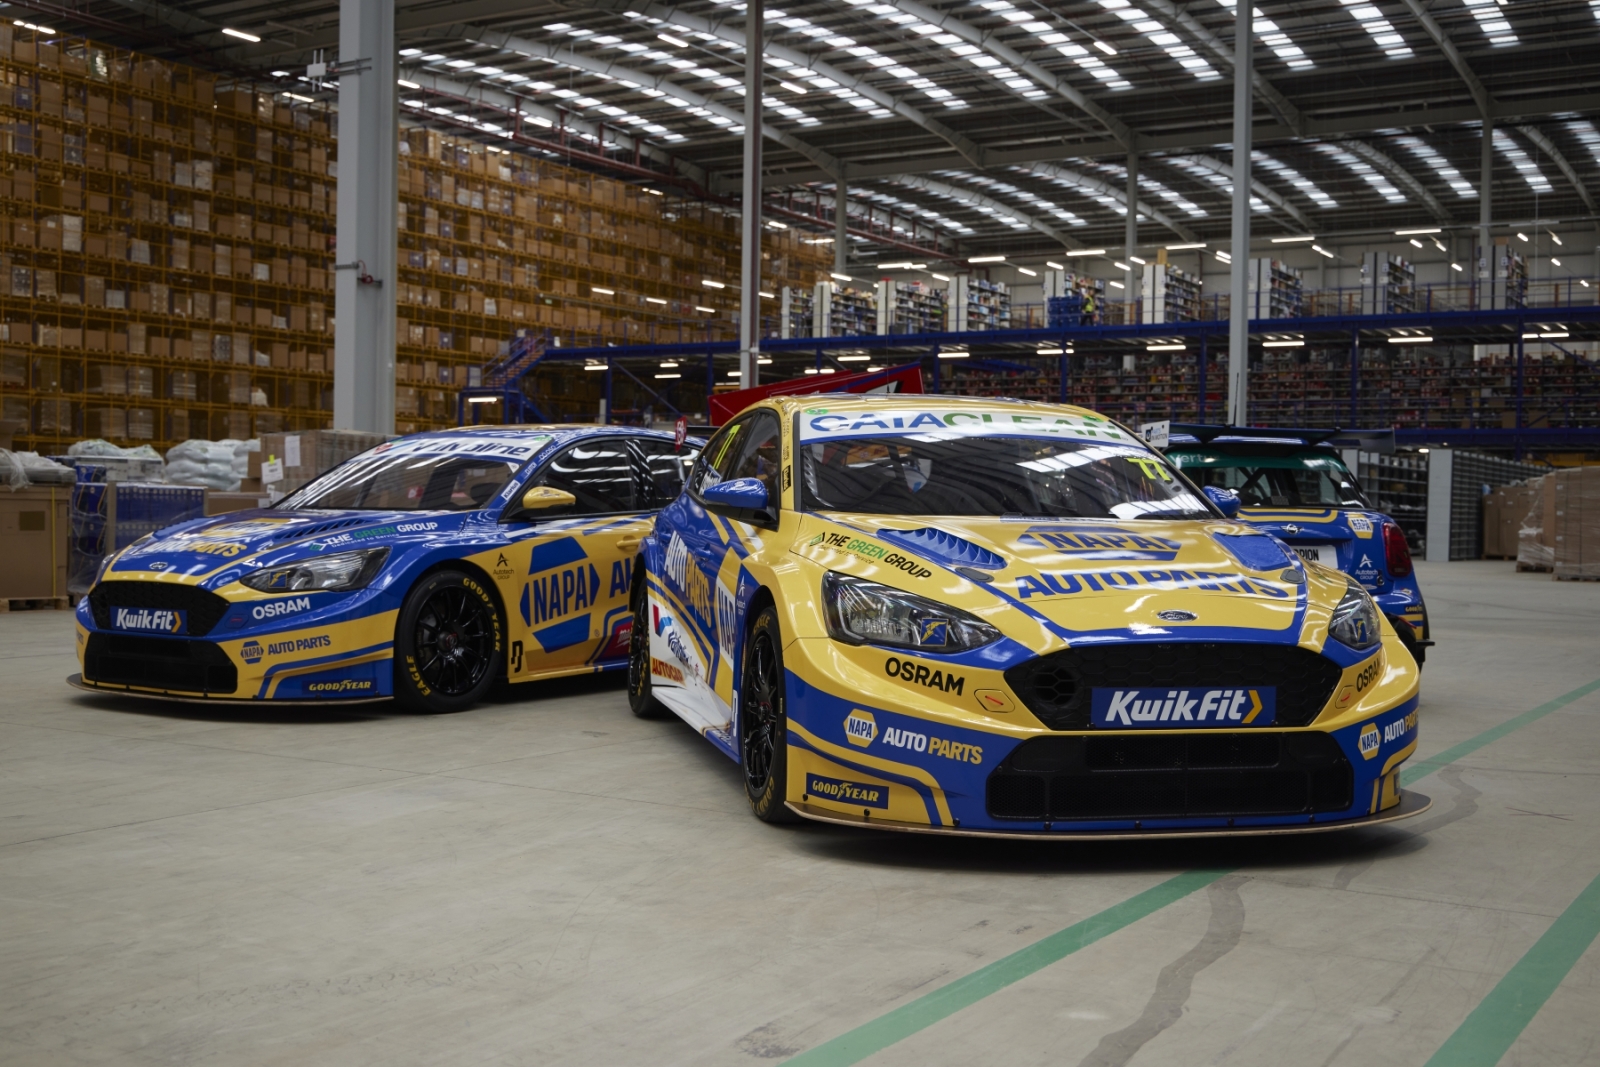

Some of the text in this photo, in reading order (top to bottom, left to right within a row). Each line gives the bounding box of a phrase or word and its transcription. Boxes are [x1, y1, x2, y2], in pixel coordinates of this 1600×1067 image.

[1126, 457, 1171, 481] 77
[354, 526, 396, 539] GREEN
[397, 521, 438, 533] GROUP
[1045, 533, 1162, 550] NAPA
[826, 532, 932, 579] THE GREEN GROUP
[532, 563, 590, 625] NAPA
[1015, 570, 1290, 599] AUTO PARTS
[252, 597, 310, 620] OSRAM
[244, 635, 331, 659] NAPA AUTO PARTS
[885, 657, 965, 696] OSRAM
[847, 717, 983, 765] NAPA AUTO PARTS
[1361, 731, 1379, 751] NAPA
[1384, 718, 1405, 743] AUTO
